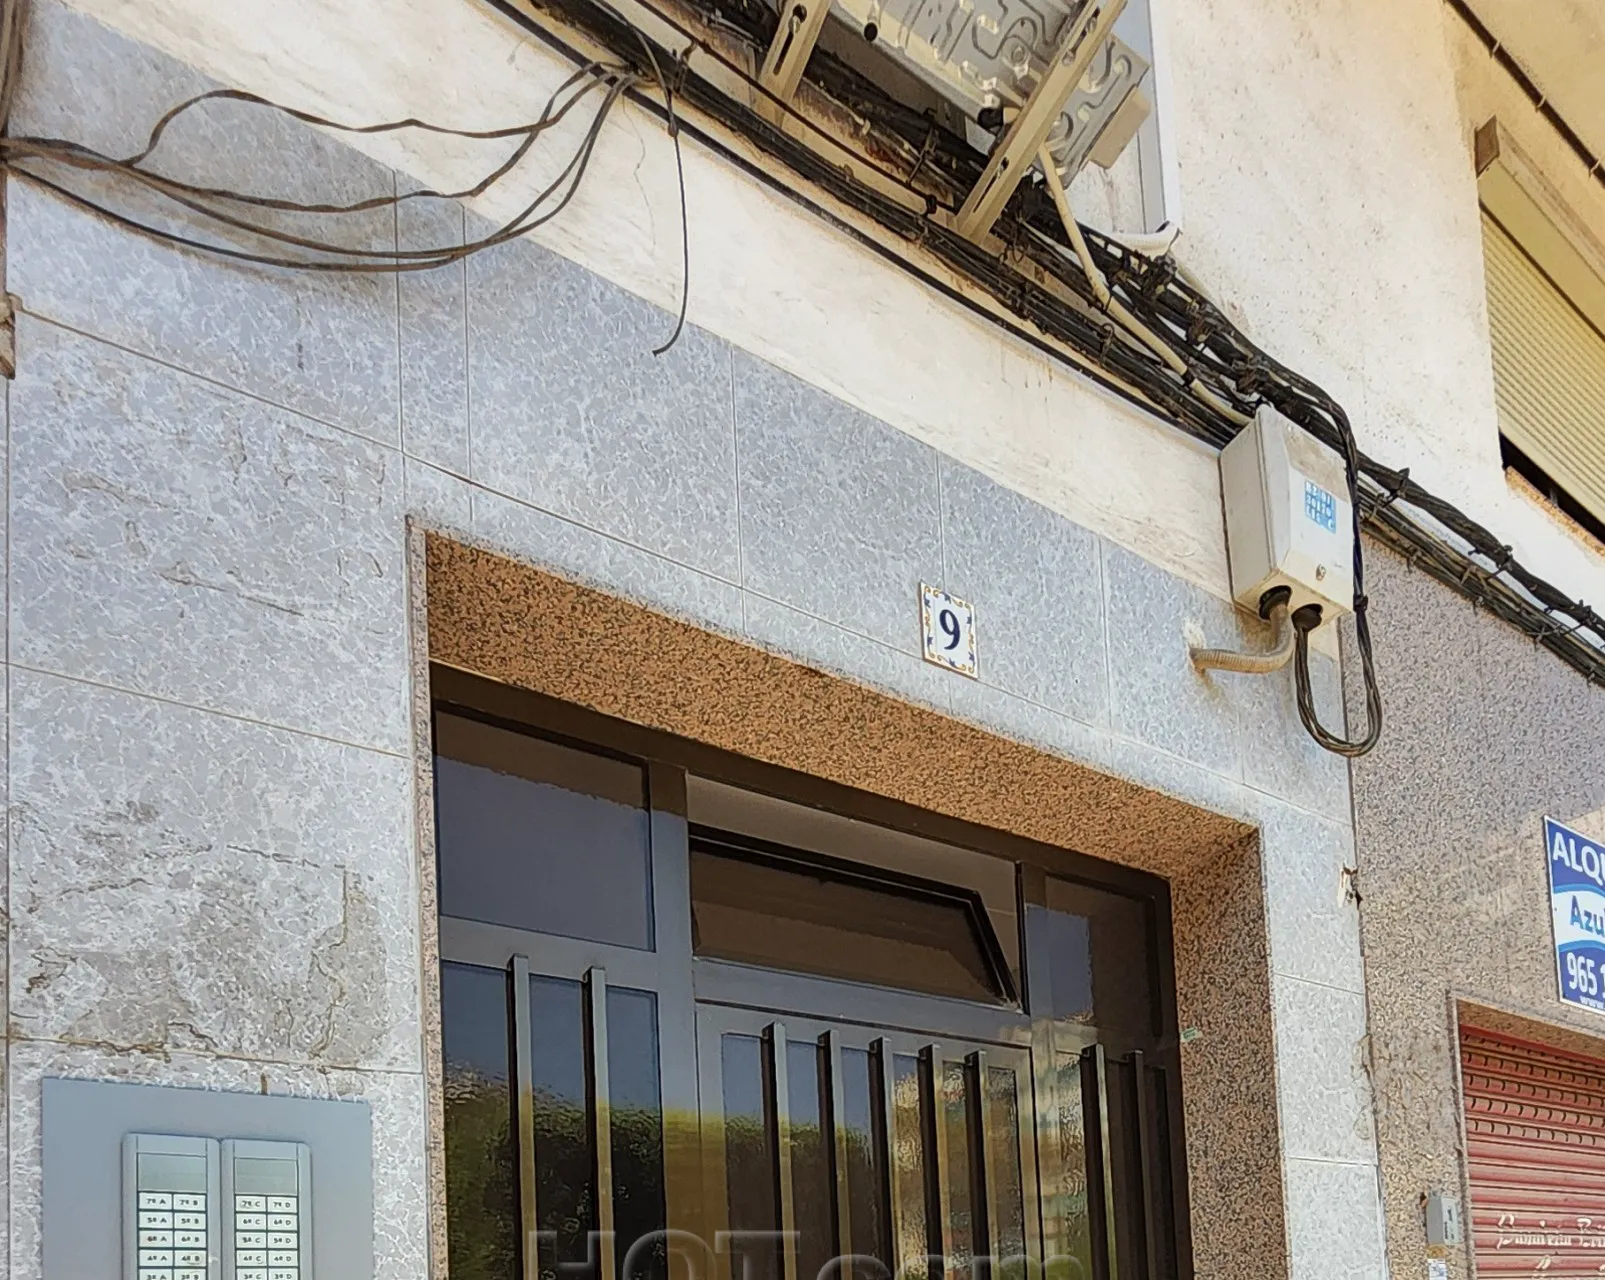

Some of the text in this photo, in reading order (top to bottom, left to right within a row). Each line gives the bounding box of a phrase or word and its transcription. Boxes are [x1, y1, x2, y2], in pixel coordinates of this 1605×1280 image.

[939, 609, 961, 650] 9
[1570, 894, 1605, 938] Azu
[1566, 952, 1598, 996] 965
